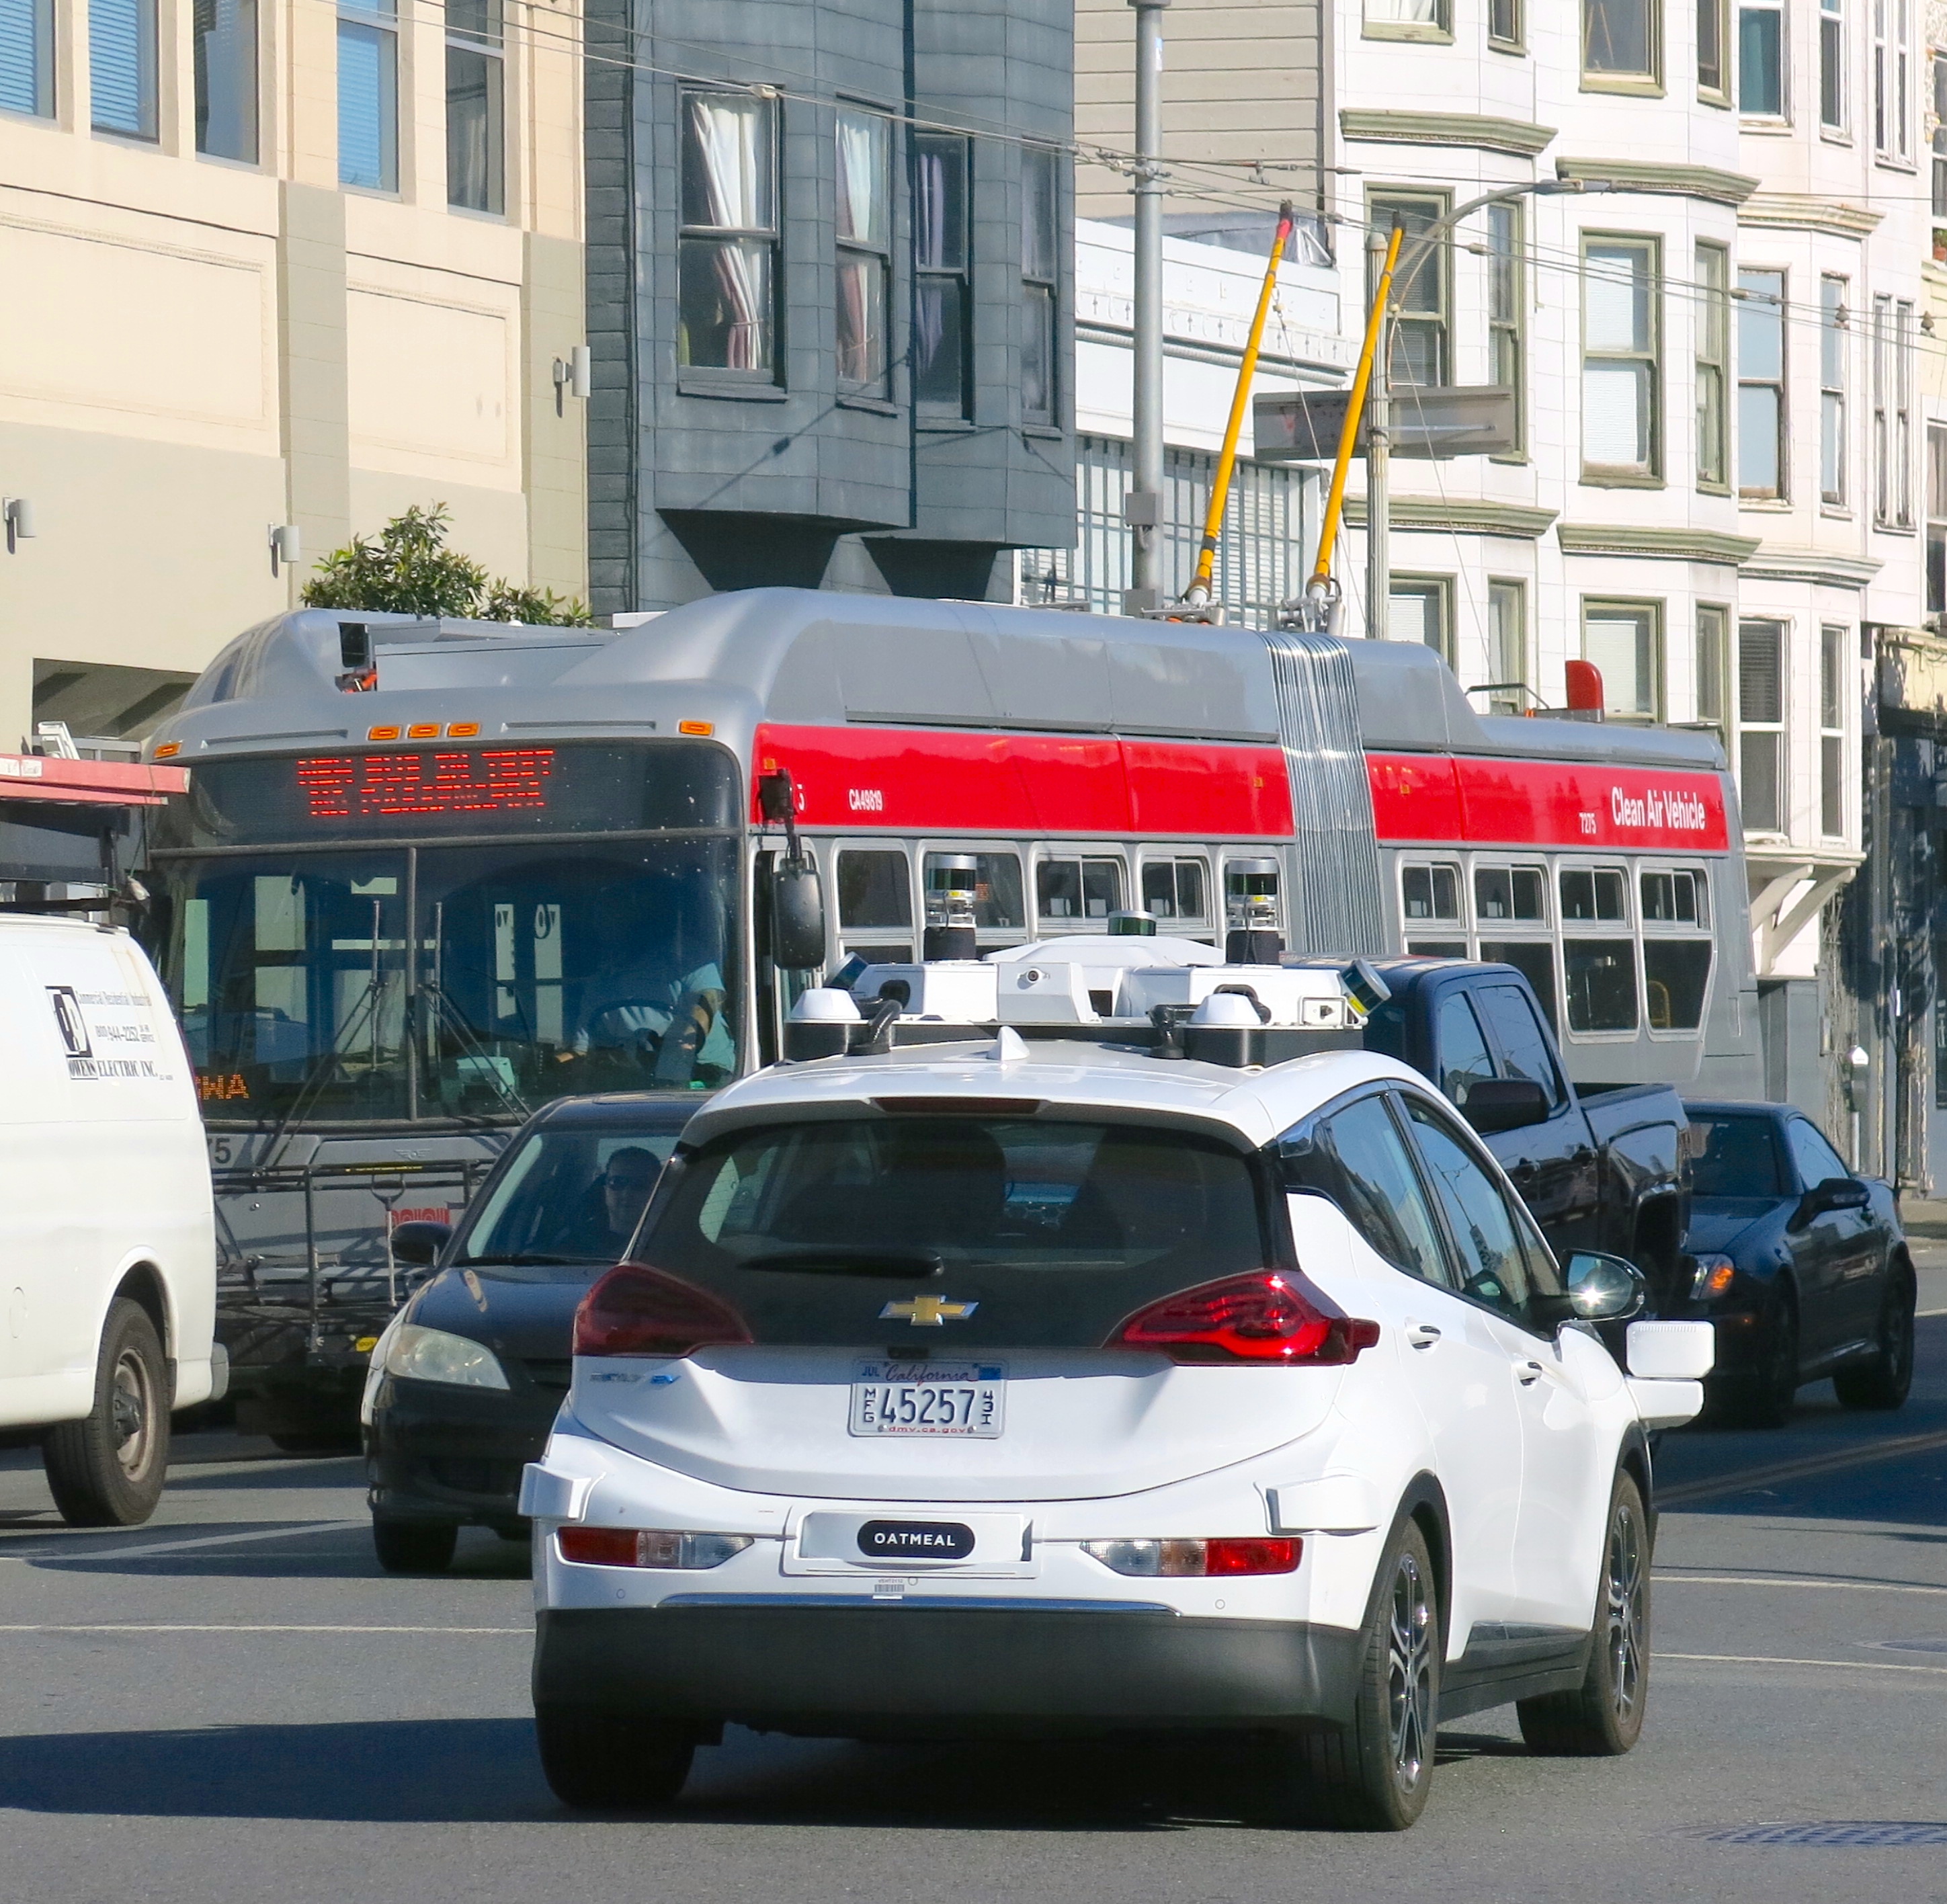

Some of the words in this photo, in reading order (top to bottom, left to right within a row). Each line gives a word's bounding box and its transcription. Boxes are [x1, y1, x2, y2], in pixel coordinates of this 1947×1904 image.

[849, 788, 883, 811] CA49819
[1612, 786, 1645, 827] Clean
[1647, 789, 1663, 827] Air
[1663, 790, 1705, 830] Vehicle
[1579, 812, 1596, 834] 7275
[97, 1059, 139, 1077] ELECTRIC
[207, 1137, 232, 1164] 5
[862, 1366, 880, 1376] JUL
[885, 1364, 976, 1386] California
[880, 1388, 976, 1425] 45257
[874, 1532, 956, 1546] OATMEAL
